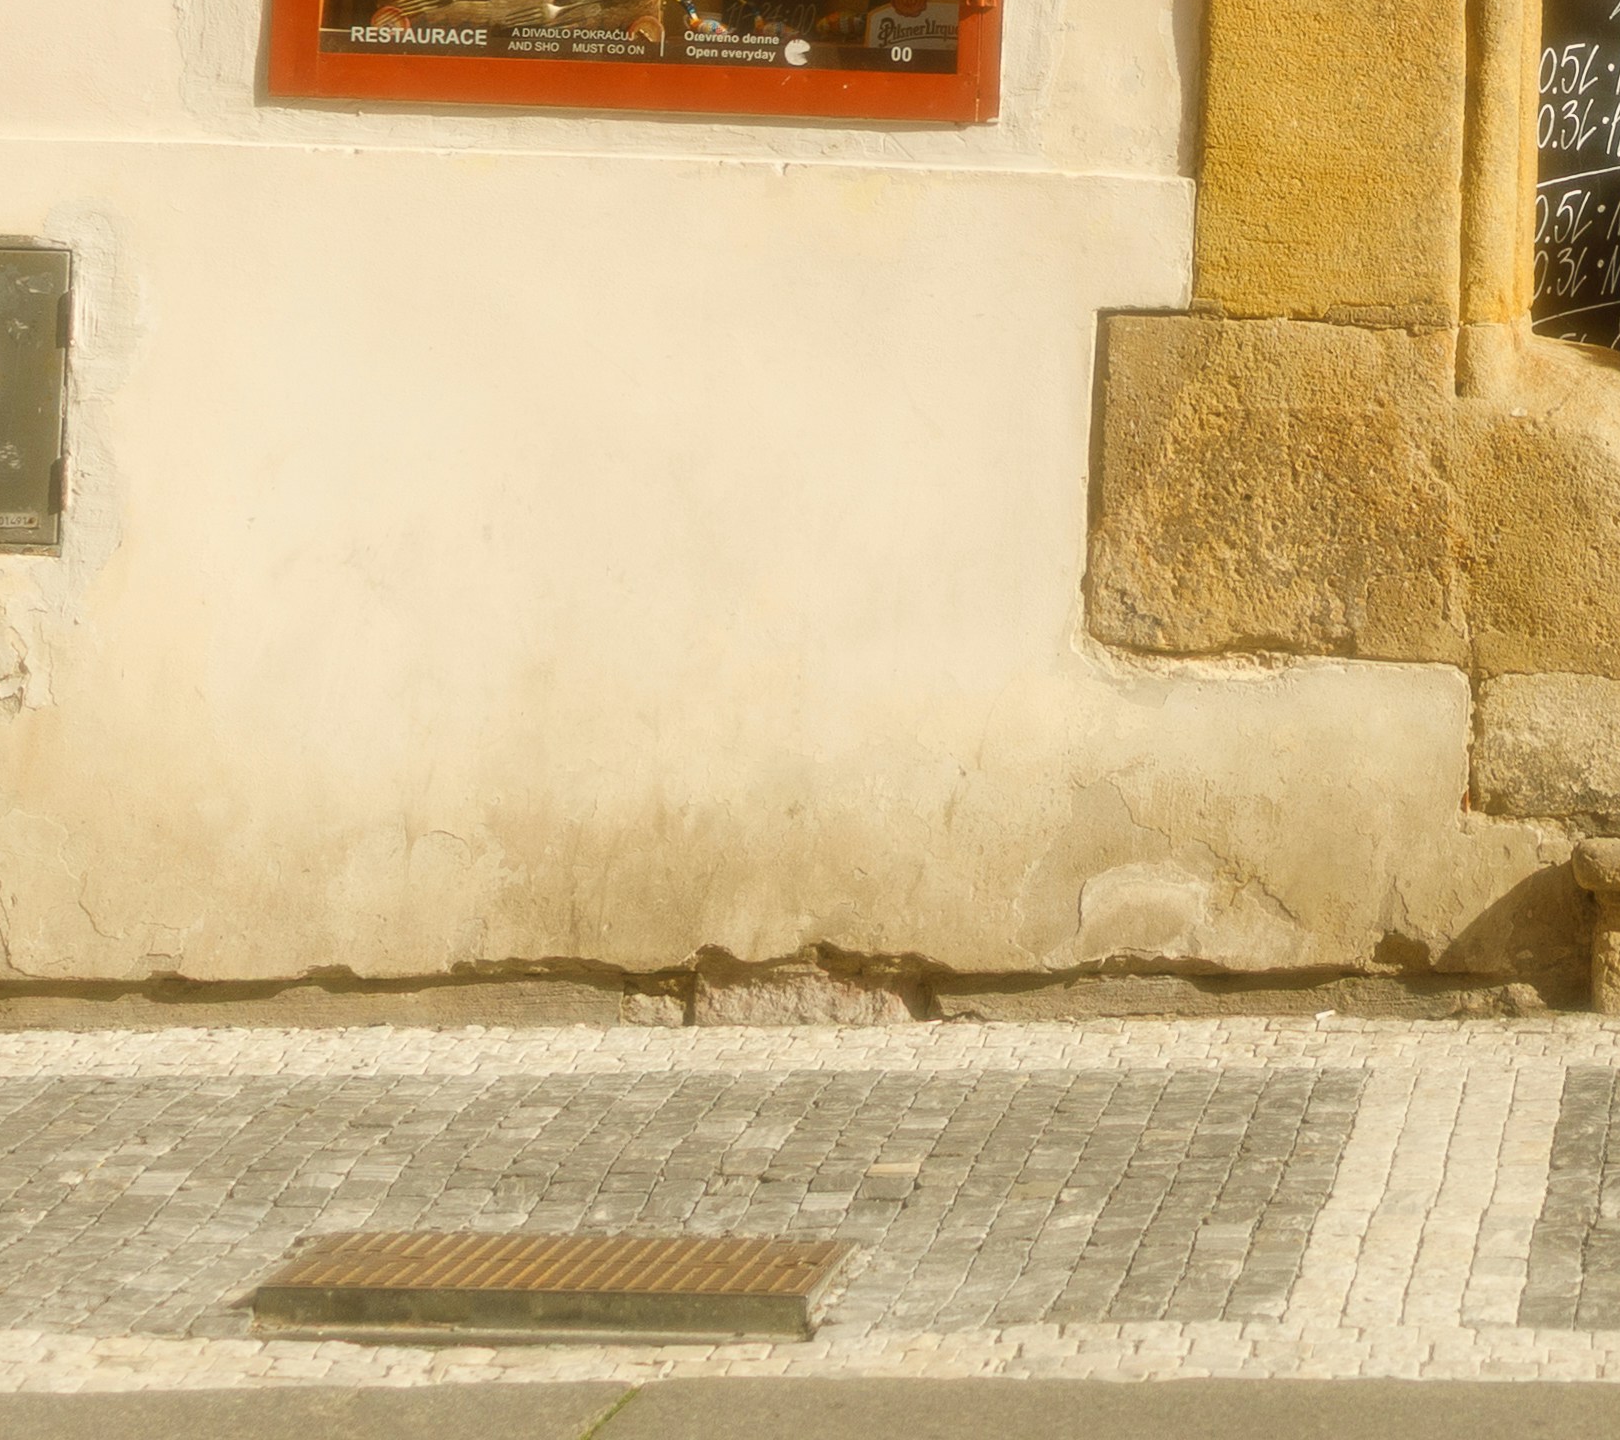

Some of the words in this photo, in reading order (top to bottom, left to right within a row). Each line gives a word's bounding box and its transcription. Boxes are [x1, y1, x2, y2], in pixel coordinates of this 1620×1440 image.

[350, 26, 487, 46] RESTAURACE
[512, 27, 521, 38] A
[522, 27, 570, 39] DIVADLO
[573, 28, 636, 42] POKRAČUJ
[877, 16, 926, 48] Pilsner
[508, 41, 532, 52] AND
[572, 43, 604, 54] MUST
[607, 44, 625, 55] GO
[627, 45, 645, 56] ON
[686, 45, 718, 59] Open
[721, 49, 776, 63] everyday
[1538, 43, 1599, 95] 0.5L
[1536, 98, 1597, 151] 0.3L
